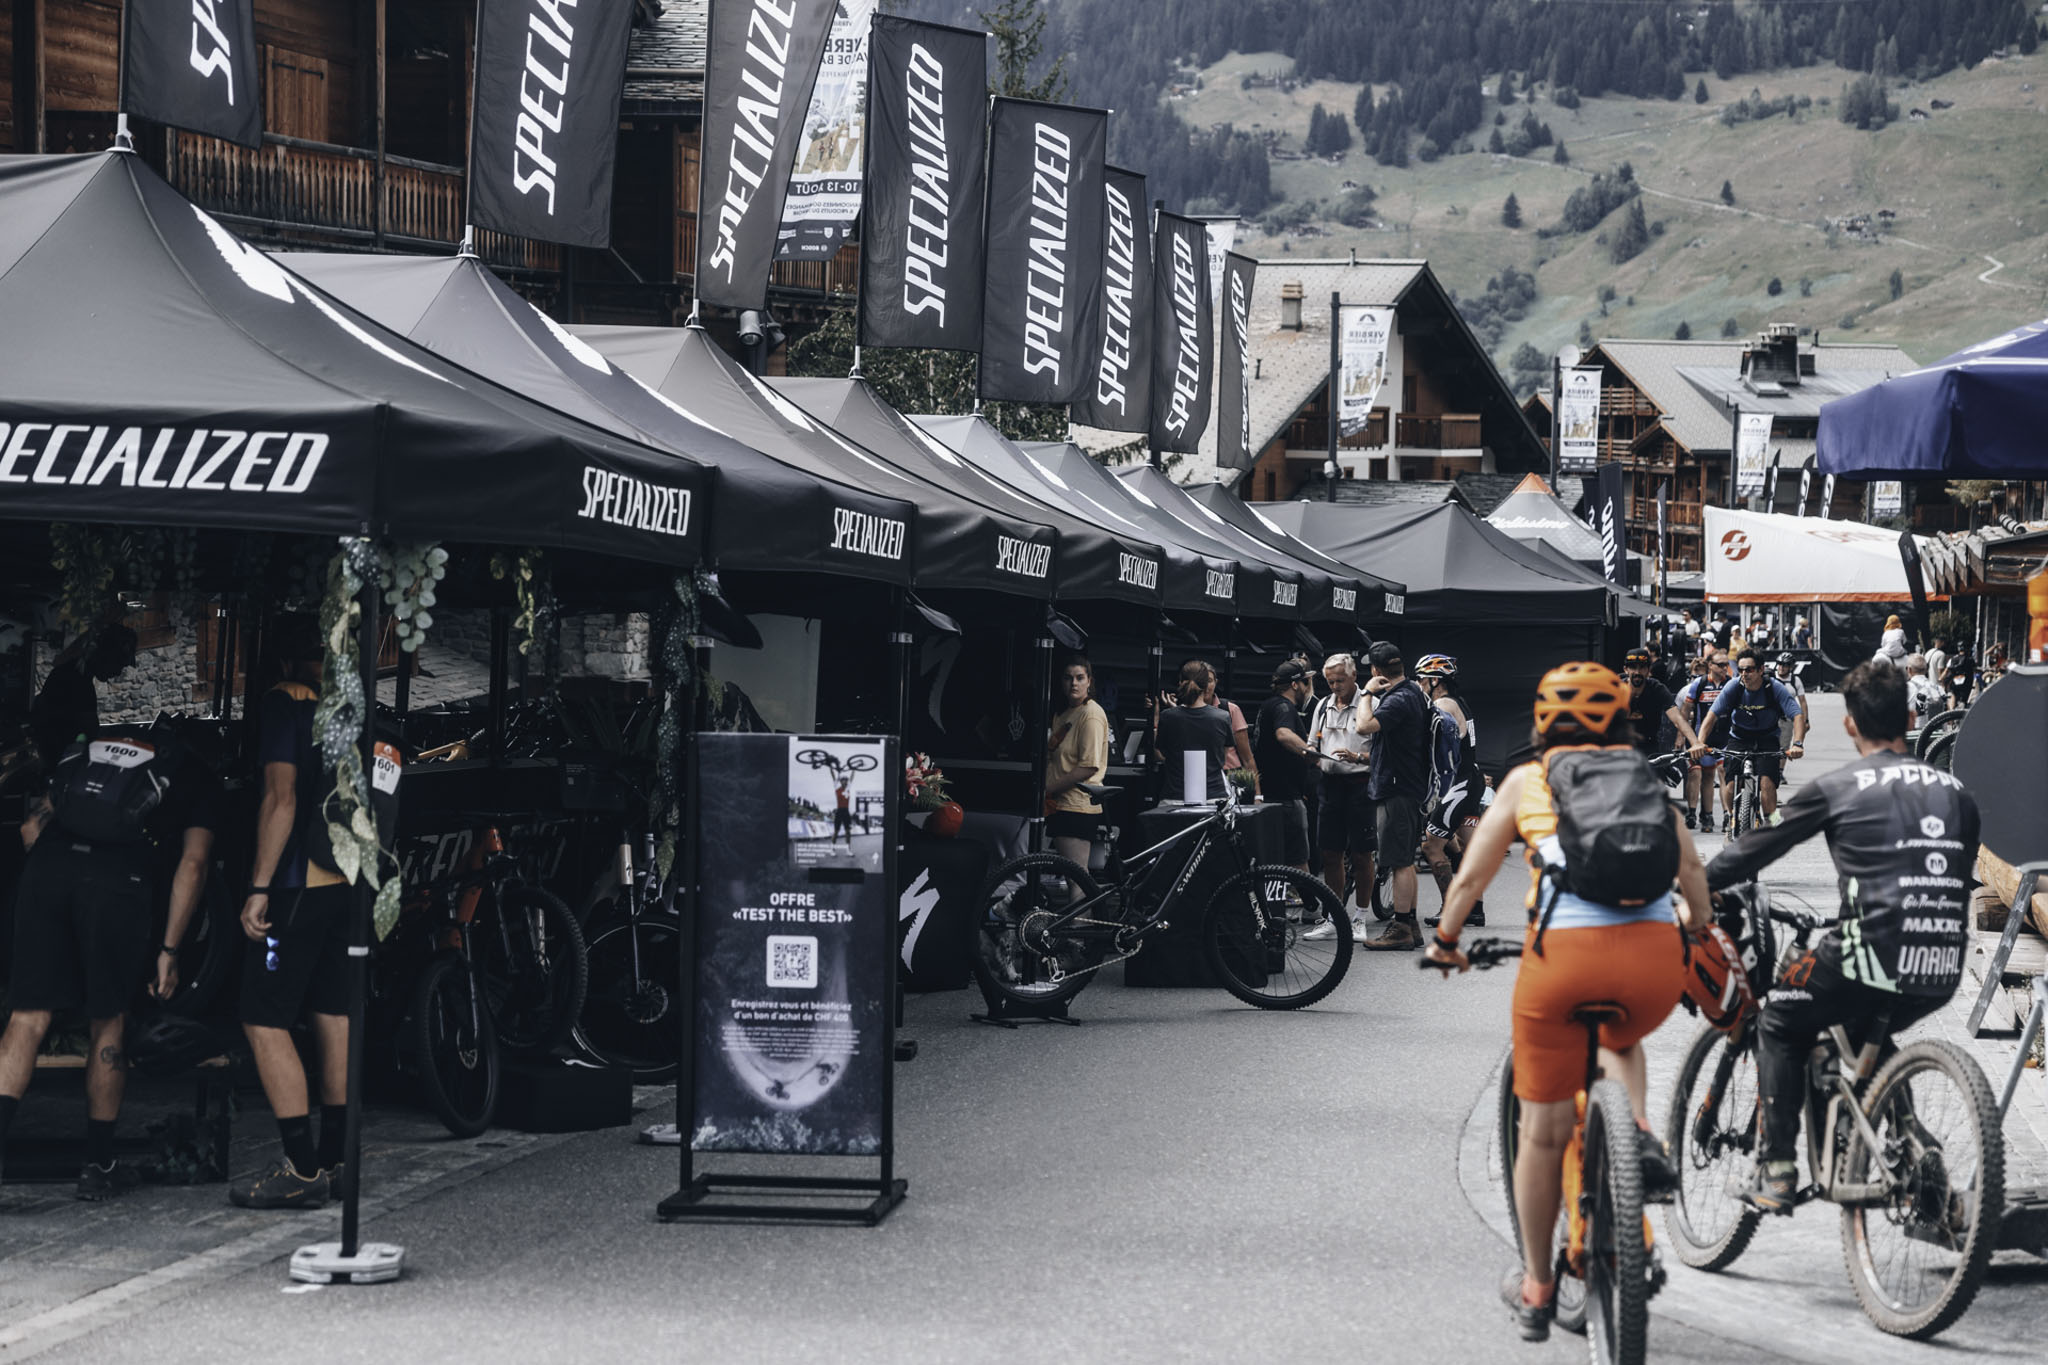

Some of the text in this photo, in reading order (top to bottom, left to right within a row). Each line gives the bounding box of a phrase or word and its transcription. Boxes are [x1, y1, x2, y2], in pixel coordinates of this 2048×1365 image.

[903, 43, 949, 328] SPECIALIZED
[1023, 122, 1071, 385] SPECIALIZED
[1097, 182, 1134, 416] SPECIALIZED
[1165, 232, 1200, 439] SPECIALIZED
[577, 466, 691, 536] SPECIALIZED
[830, 507, 905, 560] SPECIALIZED
[996, 535, 1051, 578] SPECIALIZED
[1118, 552, 1158, 589] SPECIALIZED
[104, 744, 138, 757] 1600
[769, 892, 816, 906] OFFRE
[778, 908, 808, 921] THE
[731, 998, 779, 1010] Enregistrez
[780, 1001, 799, 1010] vous
[800, 1001, 810, 1011] et
[754, 1011, 770, 1020] bon
[802, 1012, 813, 1021] de
[814, 1012, 832, 1021] CHF
